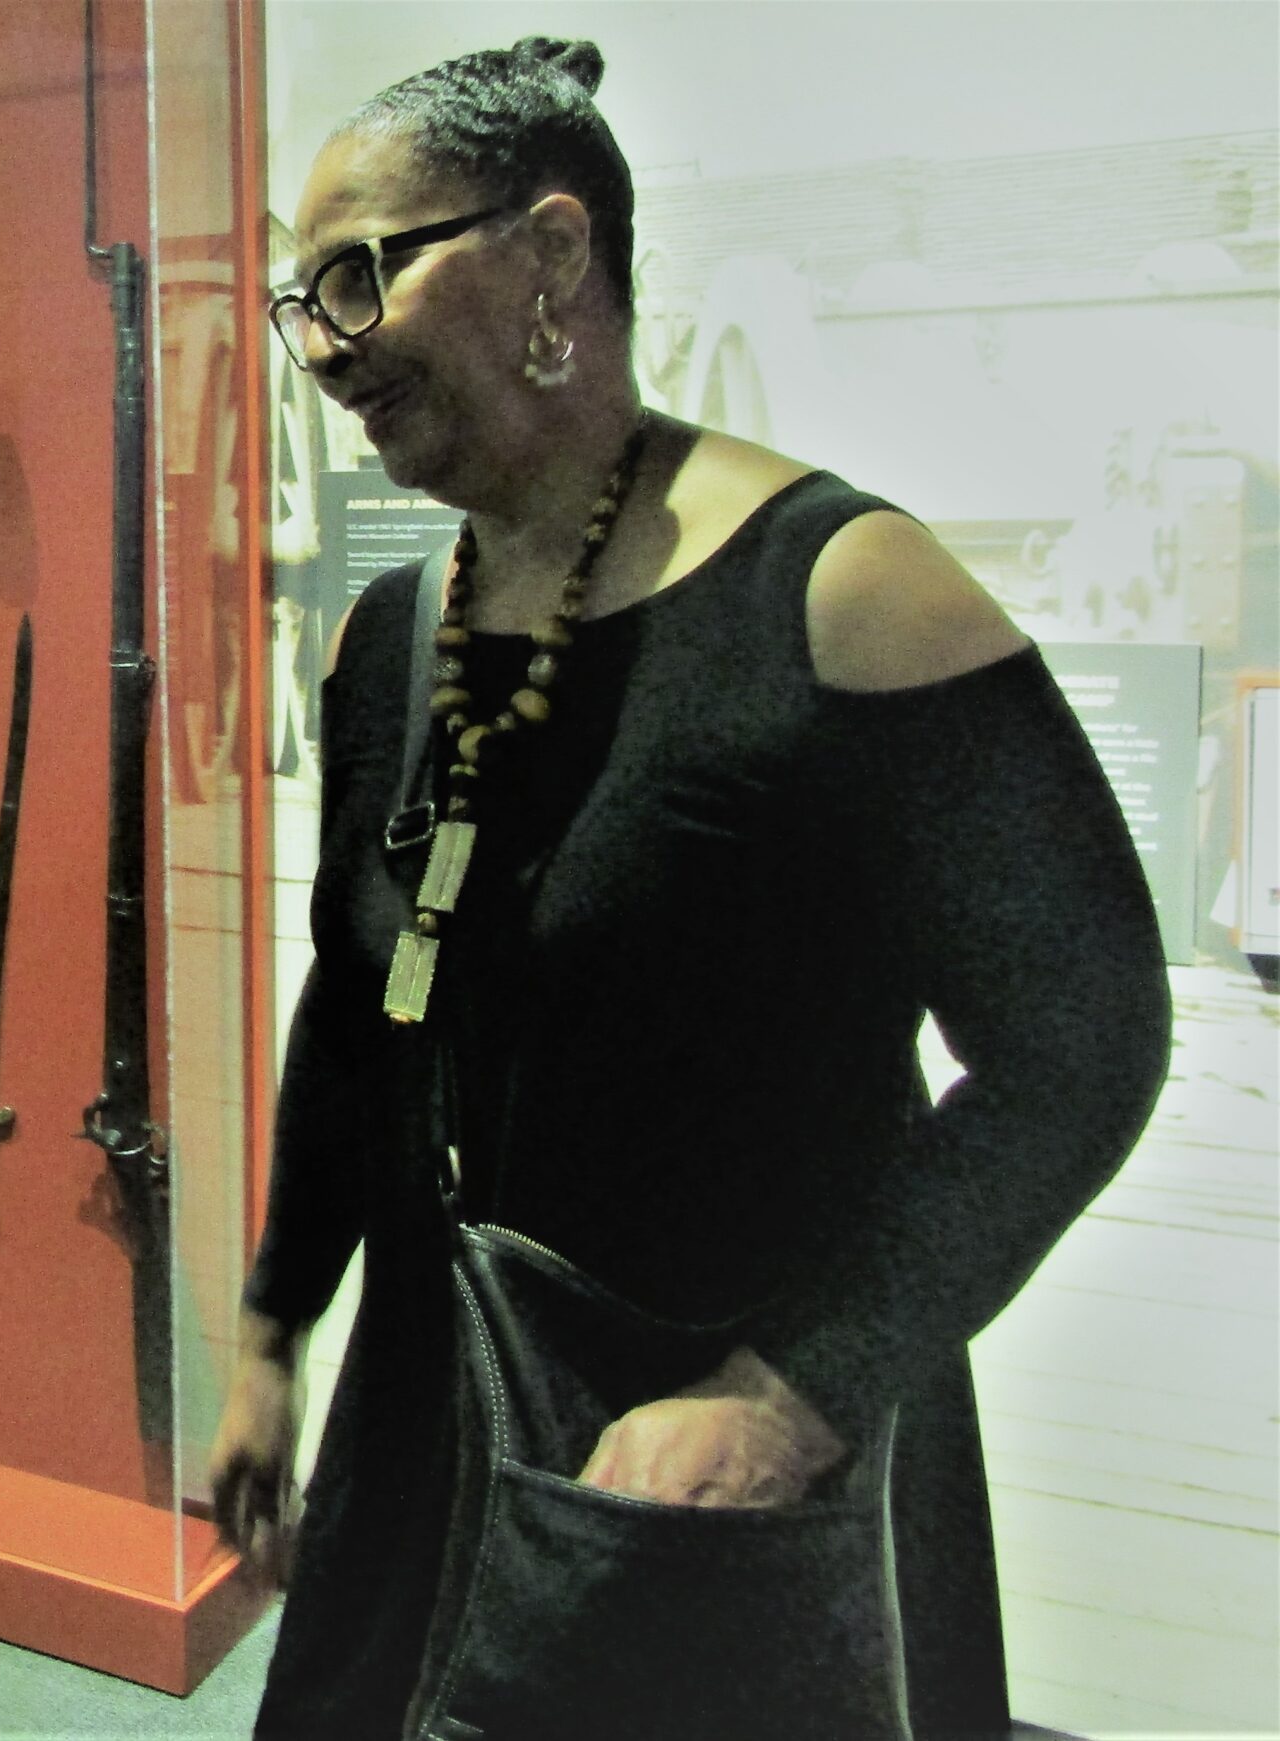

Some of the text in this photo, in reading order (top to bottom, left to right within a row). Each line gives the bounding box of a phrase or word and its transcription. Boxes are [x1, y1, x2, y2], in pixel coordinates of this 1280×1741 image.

[346, 499, 450, 509] ARMS AND AMM
